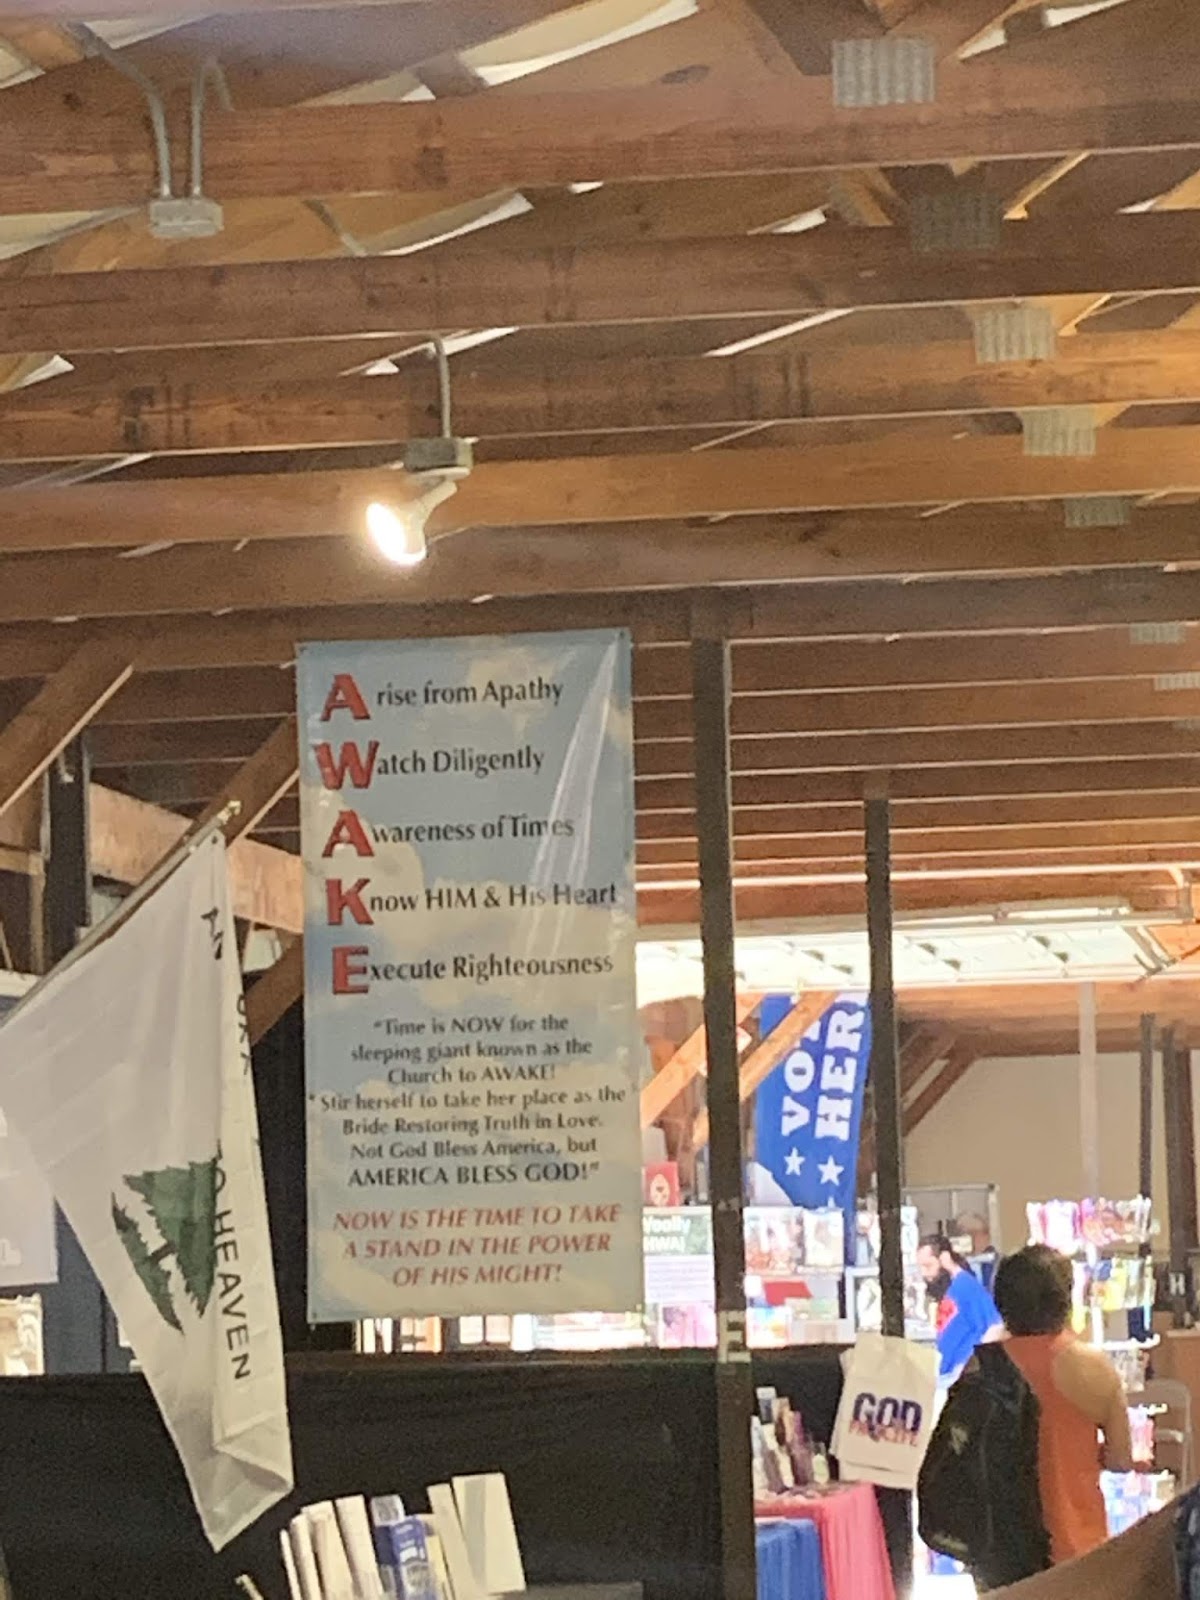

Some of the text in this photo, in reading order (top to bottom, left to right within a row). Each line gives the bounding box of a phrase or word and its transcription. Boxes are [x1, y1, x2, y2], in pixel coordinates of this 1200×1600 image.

[424, 681, 477, 704] from
[482, 677, 564, 708] Apathy
[433, 746, 544, 777] Diligently
[482, 816, 504, 838] of
[510, 814, 574, 837] Times
[425, 888, 477, 910] HIM
[483, 887, 501, 907] &
[509, 885, 546, 906] His
[553, 883, 616, 905] Heart
[453, 952, 613, 984] Righteousness
[432, 1017, 445, 1034] is
[452, 1016, 504, 1033] NOW
[510, 1015, 535, 1032] for
[542, 1014, 569, 1031] the
[351, 1038, 592, 1064] sleeping giant known as the
[388, 1065, 556, 1084] Church to AWAKE!
[356, 1092, 413, 1110] herself
[420, 1094, 437, 1108] to
[444, 1090, 481, 1108] take
[486, 1090, 516, 1107] her
[523, 1089, 568, 1110] place
[574, 1091, 592, 1103] as
[598, 1085, 625, 1102] the
[343, 1118, 389, 1135] Bride
[395, 1116, 479, 1137] Restoring
[484, 1113, 530, 1131] Truth
[536, 1112, 552, 1128] in
[351, 1136, 597, 1159] Not God Bless America, but
[348, 1166, 448, 1187] AMERICA
[457, 1165, 518, 1185] BLESS
[333, 1203, 621, 1231] NOW IS THE TIME TO TAKE
[343, 1232, 611, 1258] A STAND IN THE POWER
[392, 1263, 562, 1287] OF HIS MIGHT!
[213, 1209, 251, 1380] HEAVEN
[853, 1392, 922, 1435] GOD
